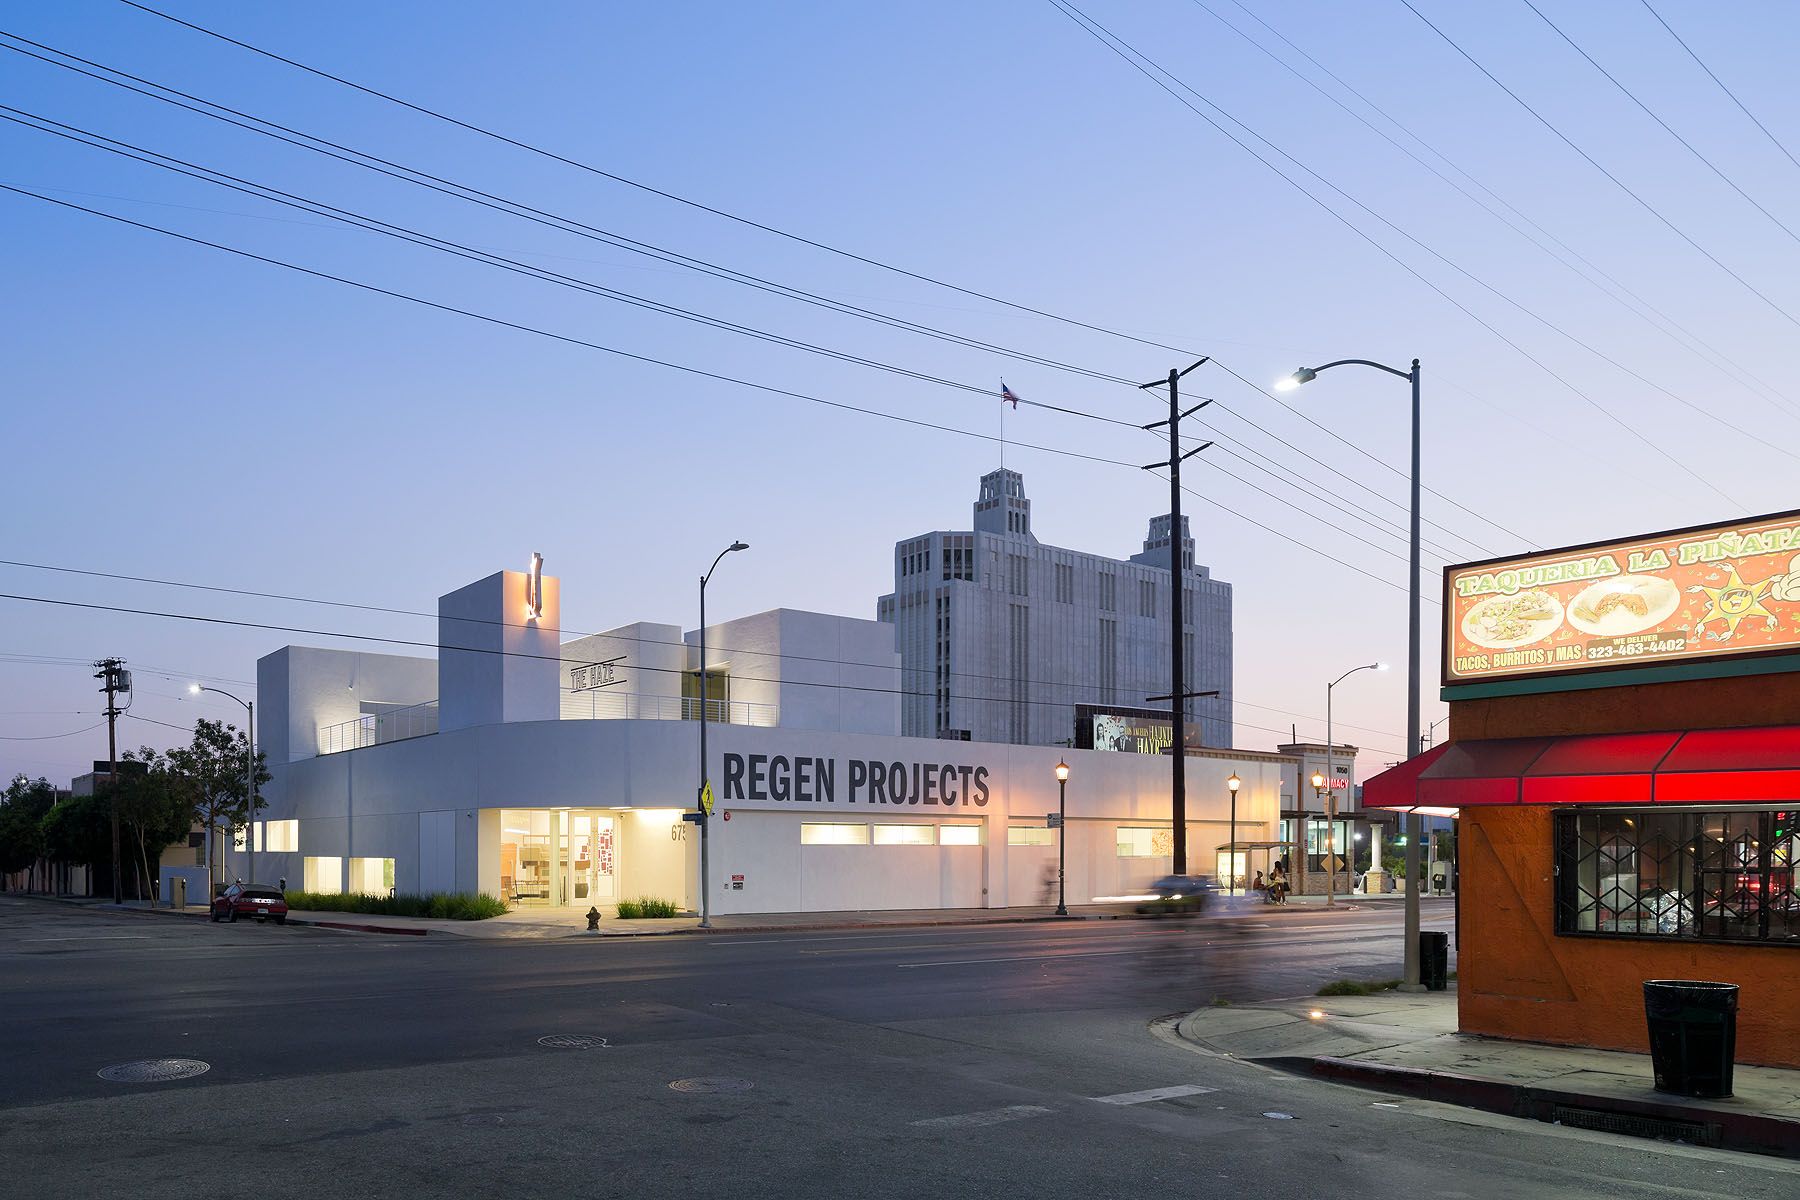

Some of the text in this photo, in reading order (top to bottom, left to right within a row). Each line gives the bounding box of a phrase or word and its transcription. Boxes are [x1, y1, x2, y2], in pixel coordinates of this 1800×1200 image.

[1457, 556, 1620, 596] TAQUERIA
[1630, 550, 1671, 575] LA
[1588, 638, 1685, 658] 323-463-4402
[1613, 634, 1658, 645] WE DELIVER
[1456, 655, 1491, 671] TACOS,
[1494, 649, 1544, 668] BURRITOS
[1556, 645, 1582, 661] MAS
[571, 662, 614, 689] THE HAZE
[723, 752, 989, 807] REGEN PROJECTS
